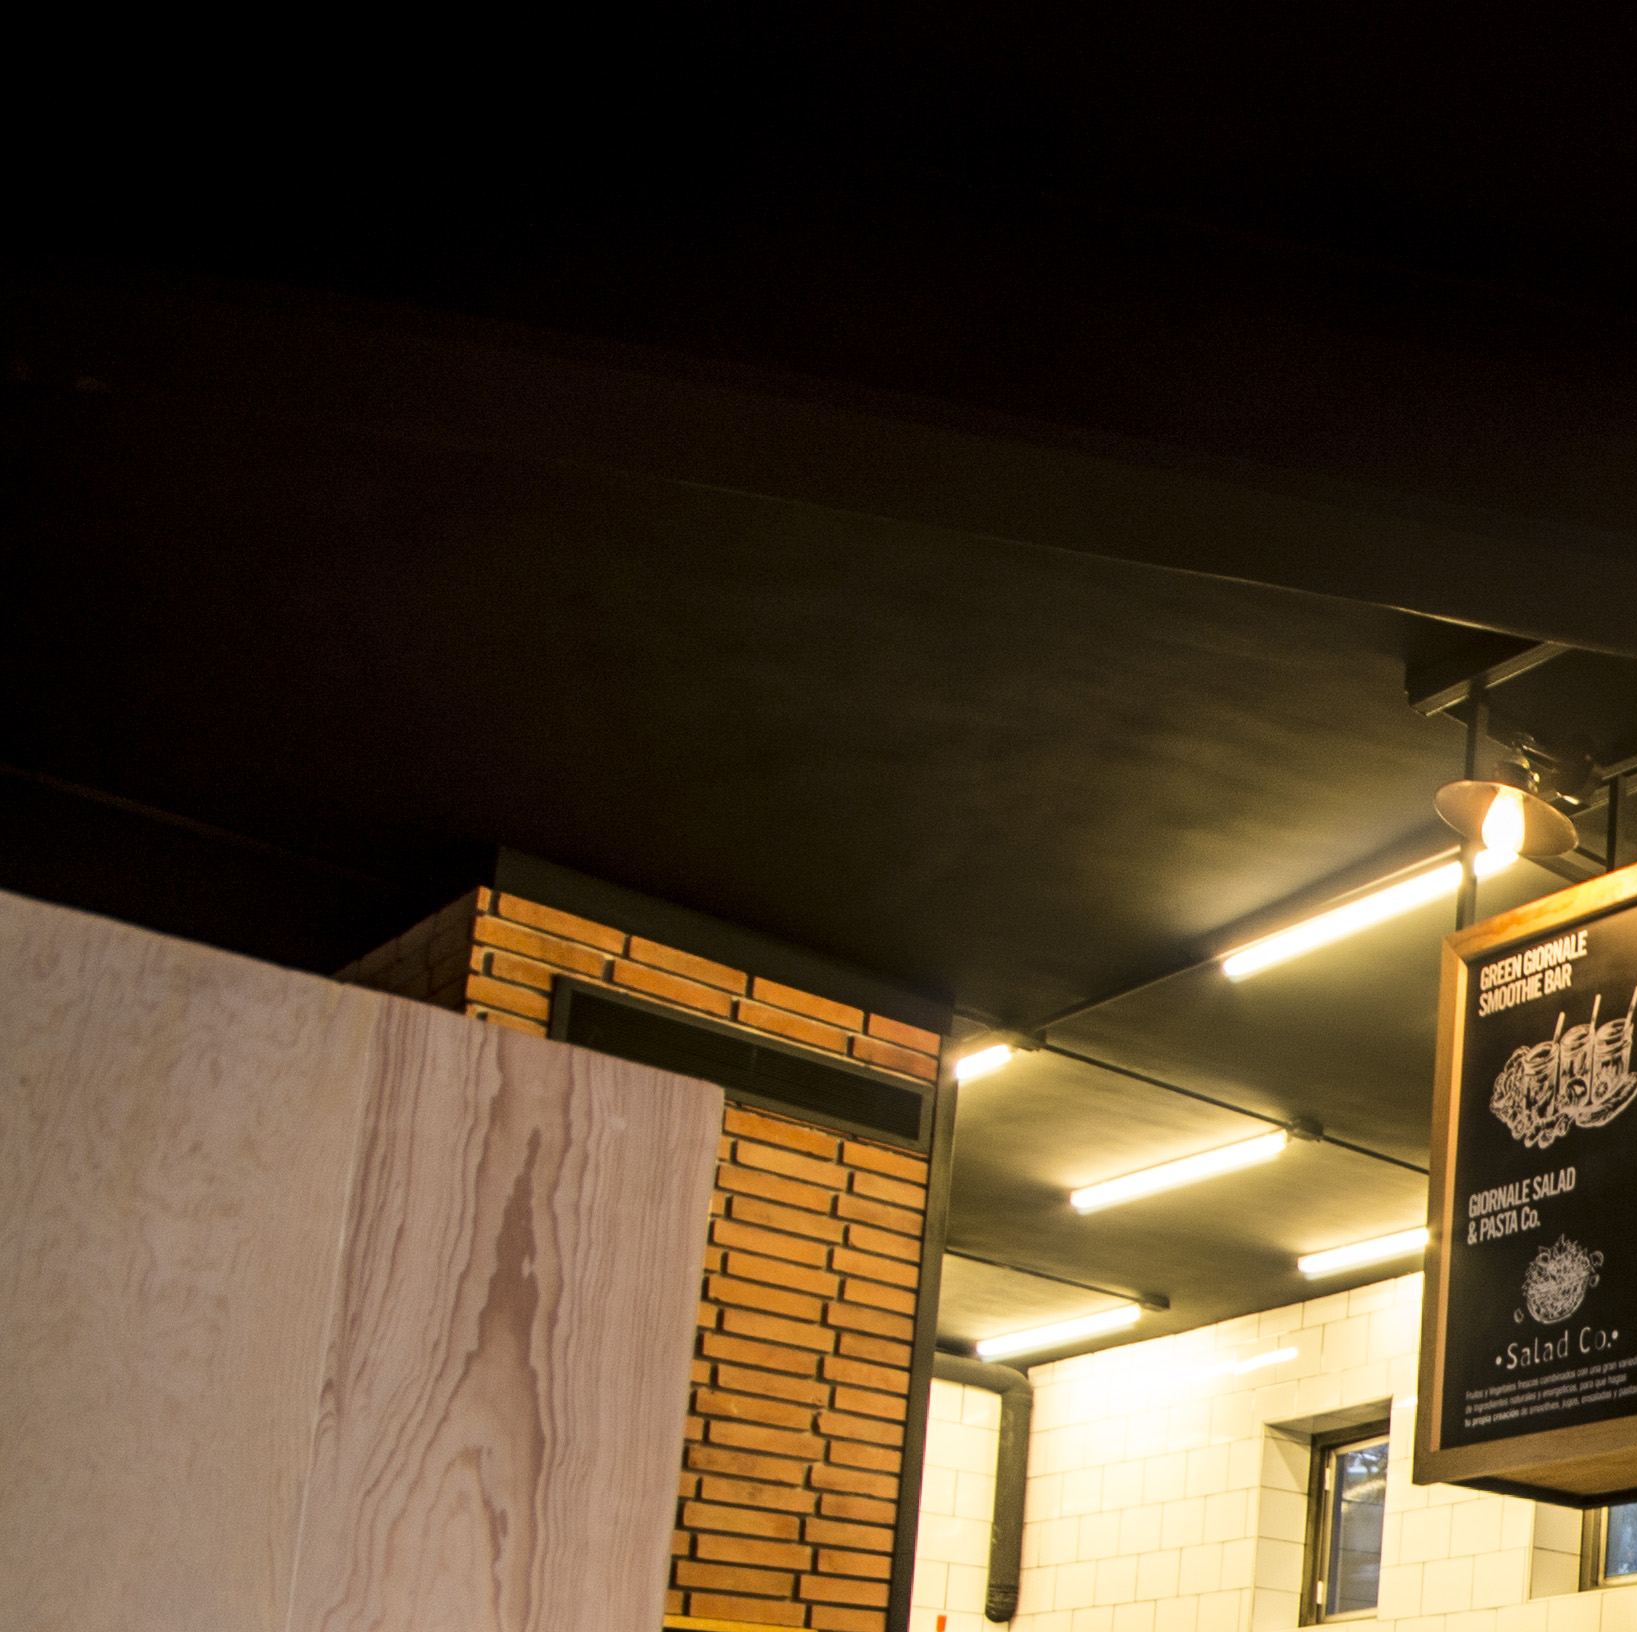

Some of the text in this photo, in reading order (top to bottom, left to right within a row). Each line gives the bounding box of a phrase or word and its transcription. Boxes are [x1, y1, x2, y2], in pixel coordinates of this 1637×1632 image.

[1479, 929, 1588, 990] GREEN GIORNALE
[1478, 962, 1572, 1016] SMOOTHIE BAR
[1468, 1166, 1575, 1218] GIORNALE SALAD
[1467, 1205, 1540, 1245] & PASTA Co.
[1506, 1326, 1613, 1369] Salad Co.
